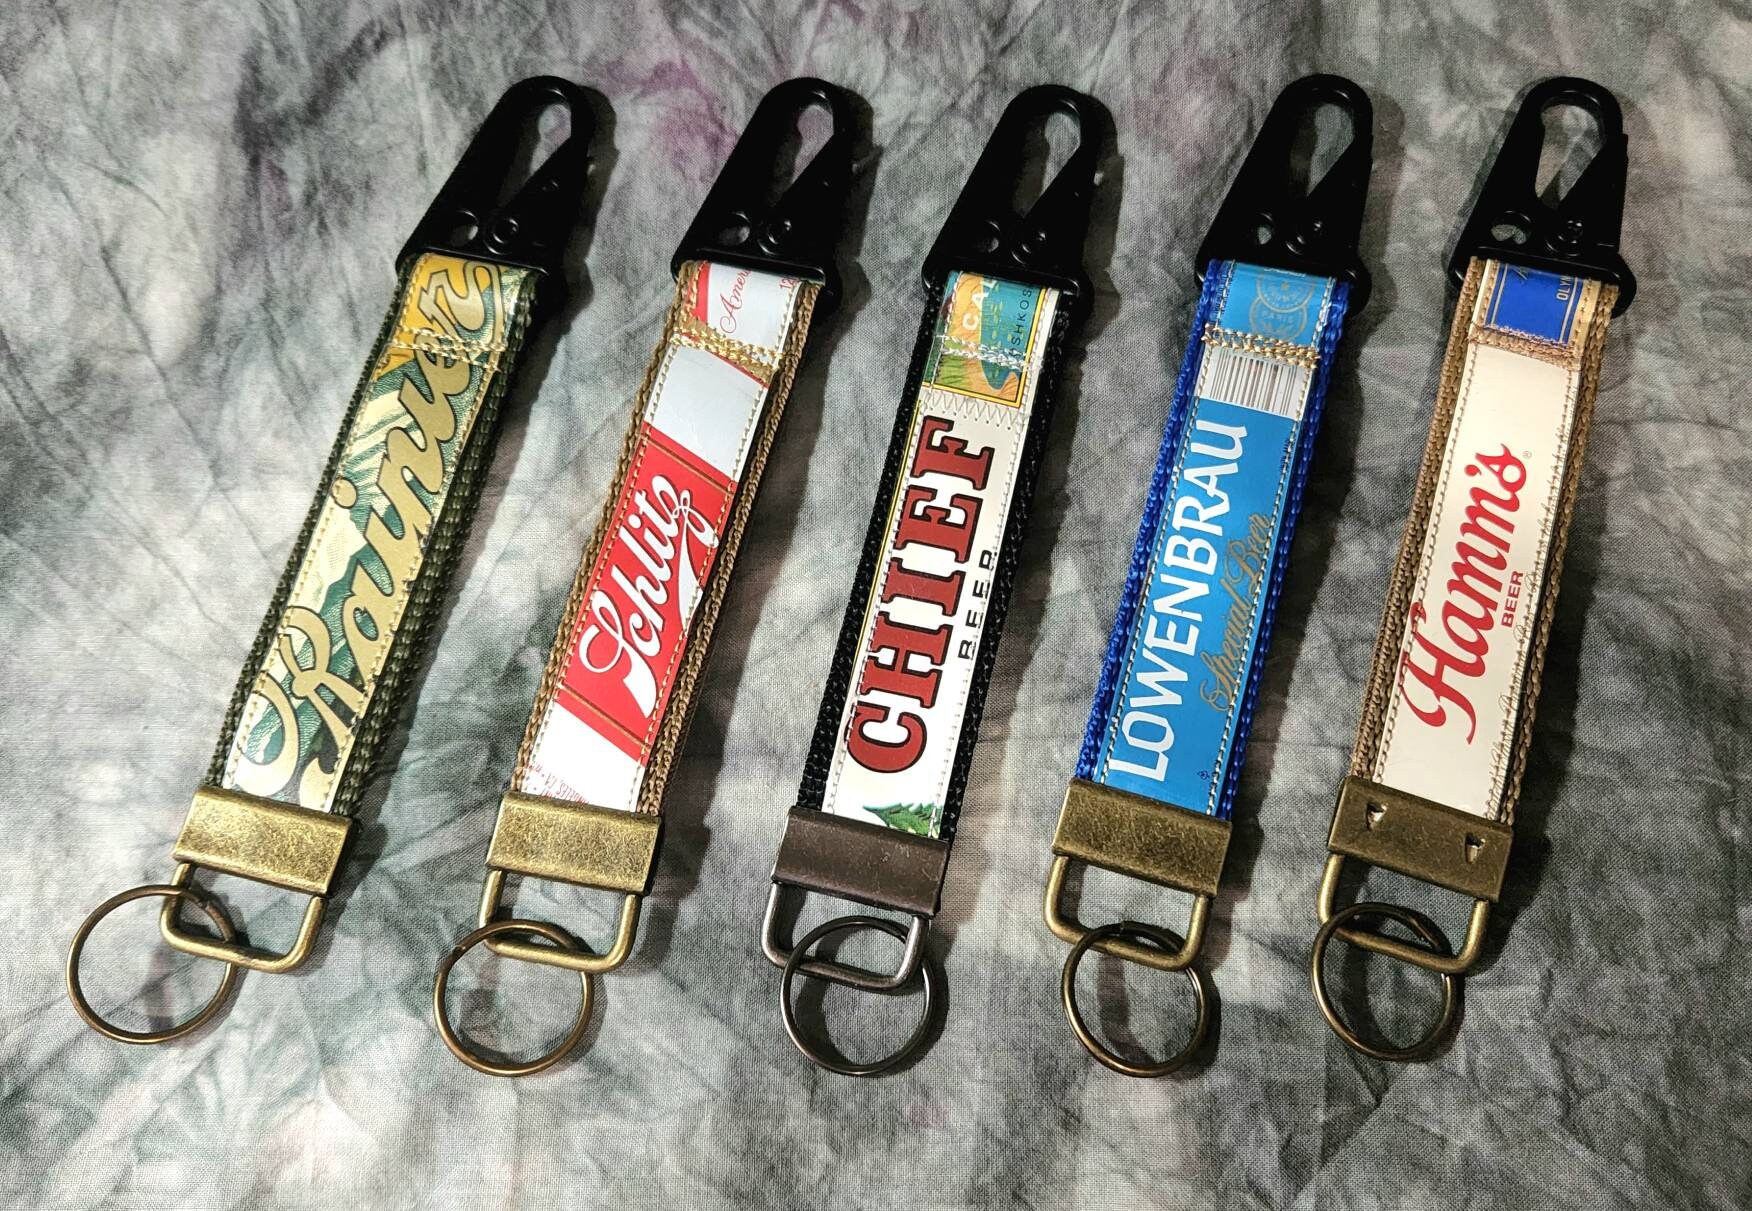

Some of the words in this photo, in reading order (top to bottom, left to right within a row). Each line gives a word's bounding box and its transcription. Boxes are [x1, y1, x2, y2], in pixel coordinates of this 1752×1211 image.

[236, 261, 505, 813] Rainier
[579, 475, 719, 718] Schlitz
[847, 415, 995, 773] CHIEF
[958, 549, 997, 660] BEER
[1224, 513, 1271, 600] Beer
[1399, 443, 1526, 744] Hamm's
[1500, 571, 1523, 628] BEER
[1200, 578, 1253, 711] Special
